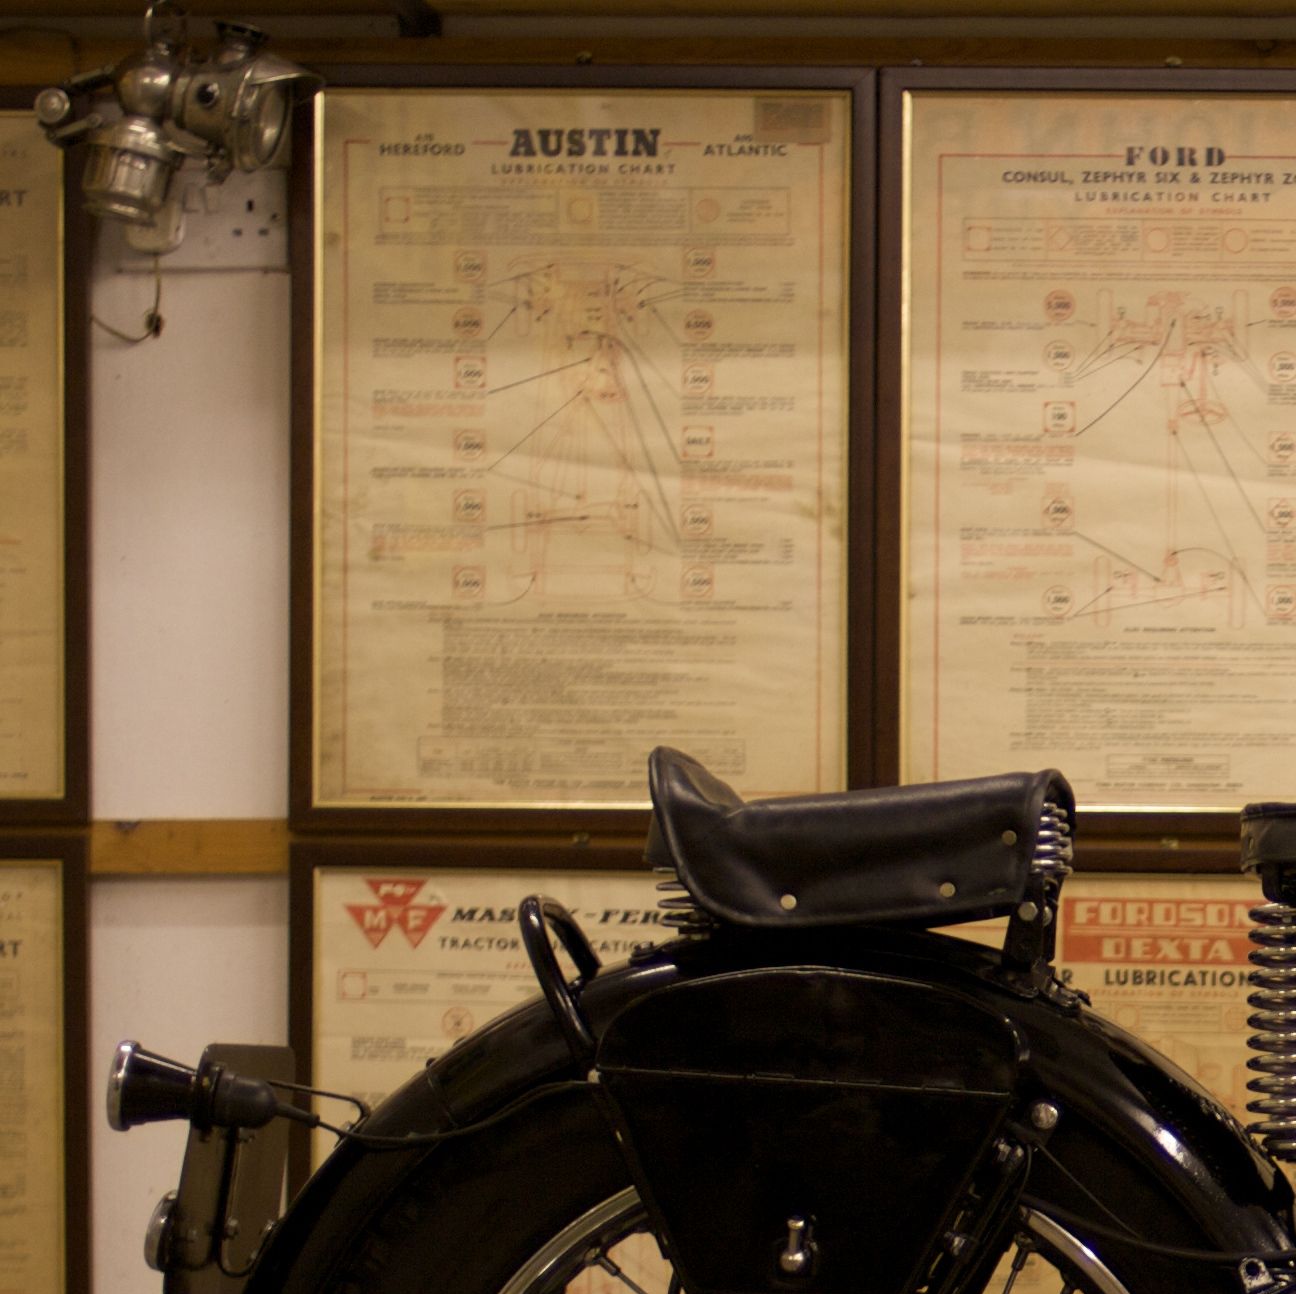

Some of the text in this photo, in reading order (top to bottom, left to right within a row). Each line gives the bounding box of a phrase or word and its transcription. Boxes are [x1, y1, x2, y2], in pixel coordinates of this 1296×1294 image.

[509, 128, 661, 158] AUSTIN
[703, 144, 787, 157] ATLANTIC
[1126, 146, 1226, 167] FORD
[491, 164, 677, 176] LUBRICATION CHART
[1002, 171, 1074, 187] CONSUL,
[1081, 171, 1147, 185] ZEPHYR
[1155, 172, 1181, 185] SIX
[1189, 172, 1201, 186] &
[1210, 172, 1275, 186] ZEPHYR
[1075, 191, 1272, 204] LUBRICATION CHART
[1074, 901, 1256, 928] FORDSON
[439, 936, 520, 951] TRACTOR
[1102, 937, 1234, 960] DEXTA
